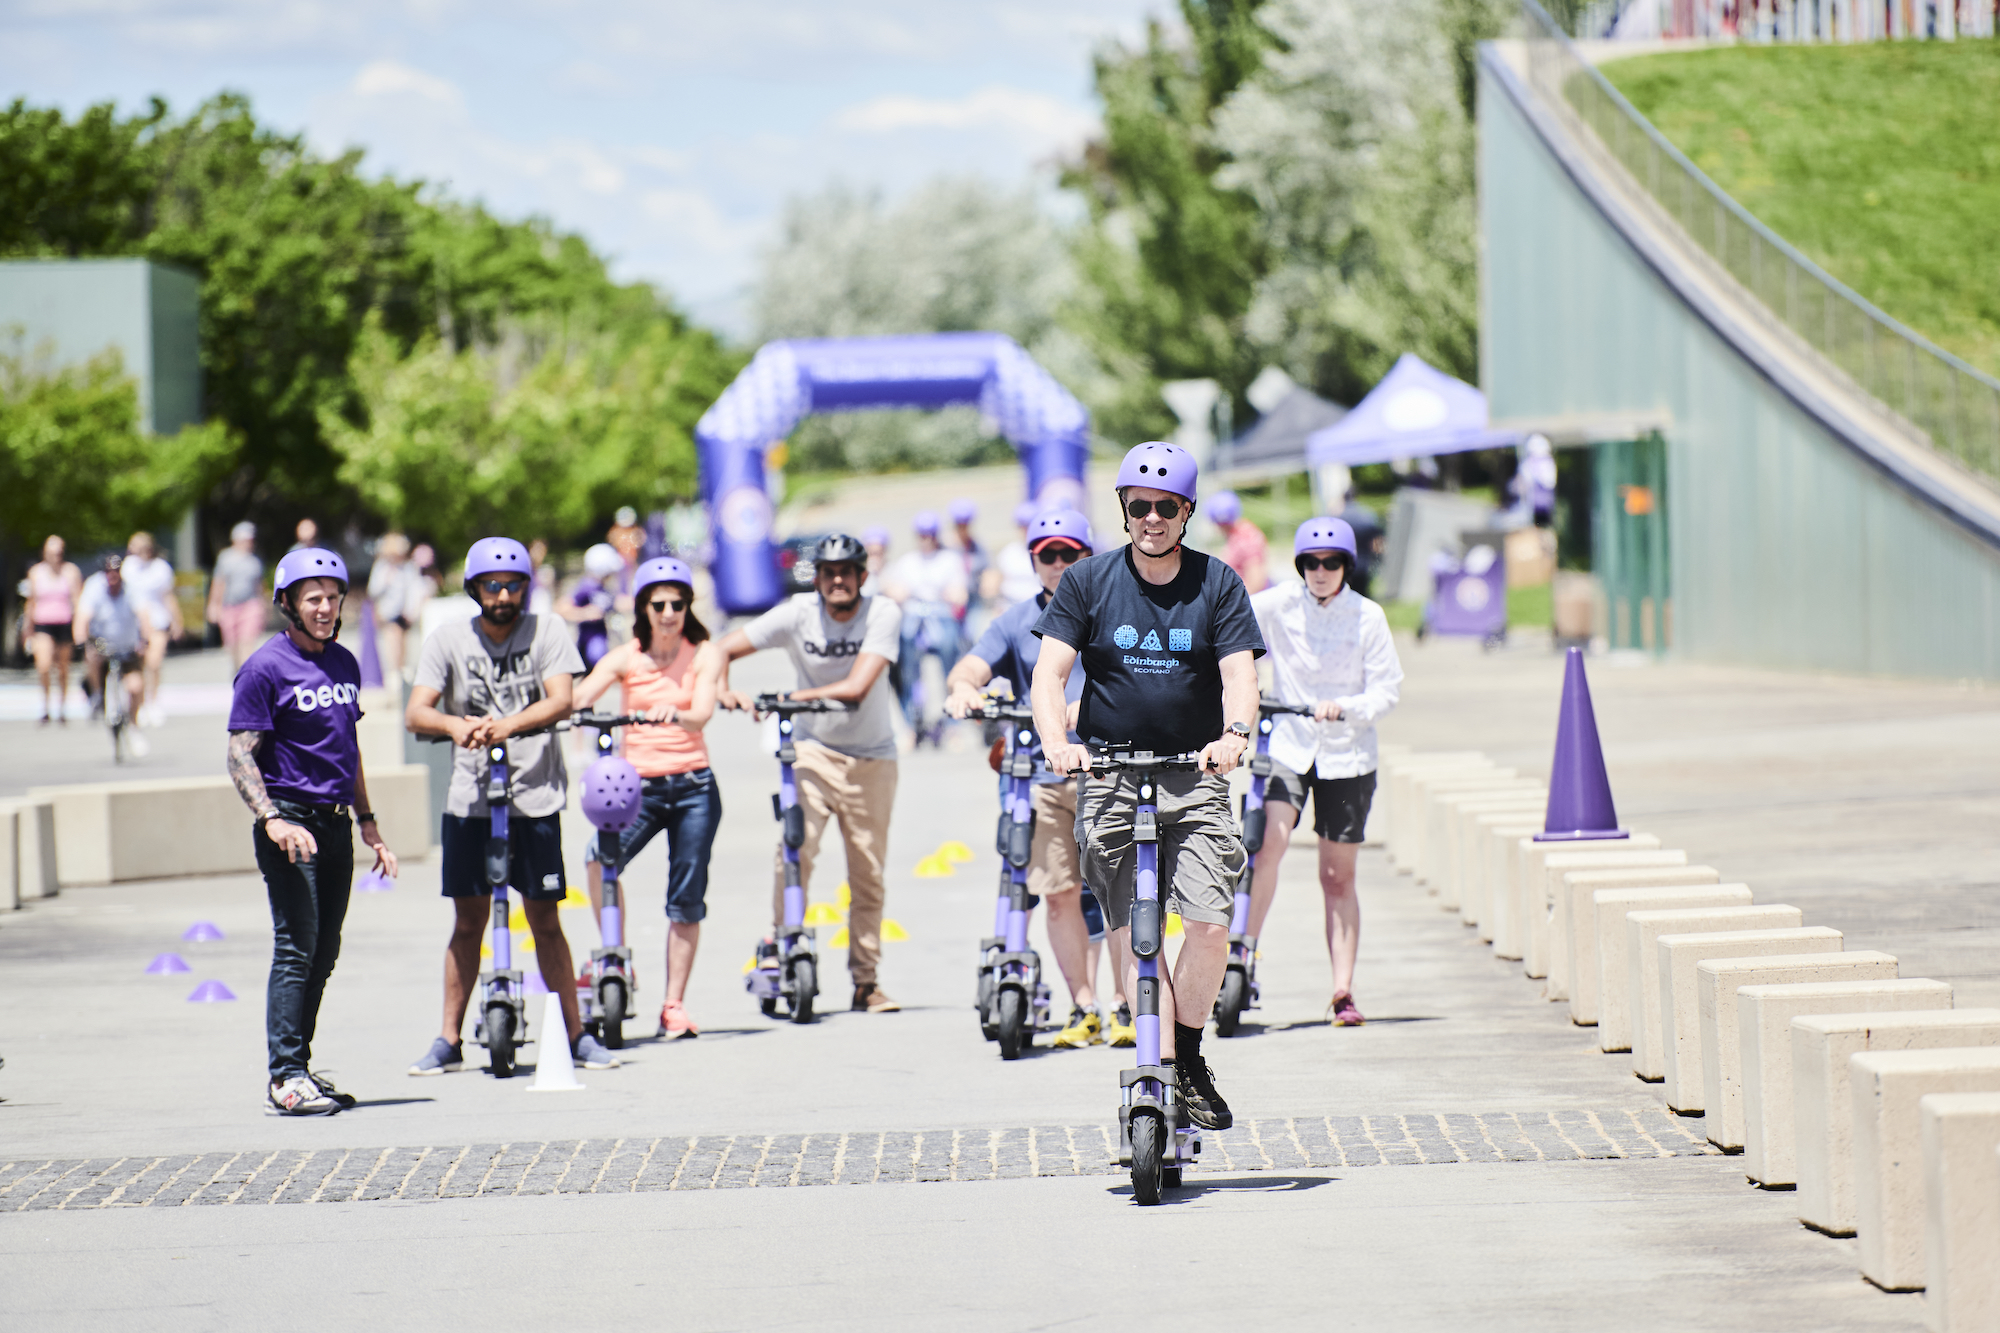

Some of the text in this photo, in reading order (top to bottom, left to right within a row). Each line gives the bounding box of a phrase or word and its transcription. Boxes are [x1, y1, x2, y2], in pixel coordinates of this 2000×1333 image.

[1123, 655, 1180, 669] Edinburgh
[1133, 667, 1171, 675] SCOTLAND
[293, 682, 360, 712] beam
